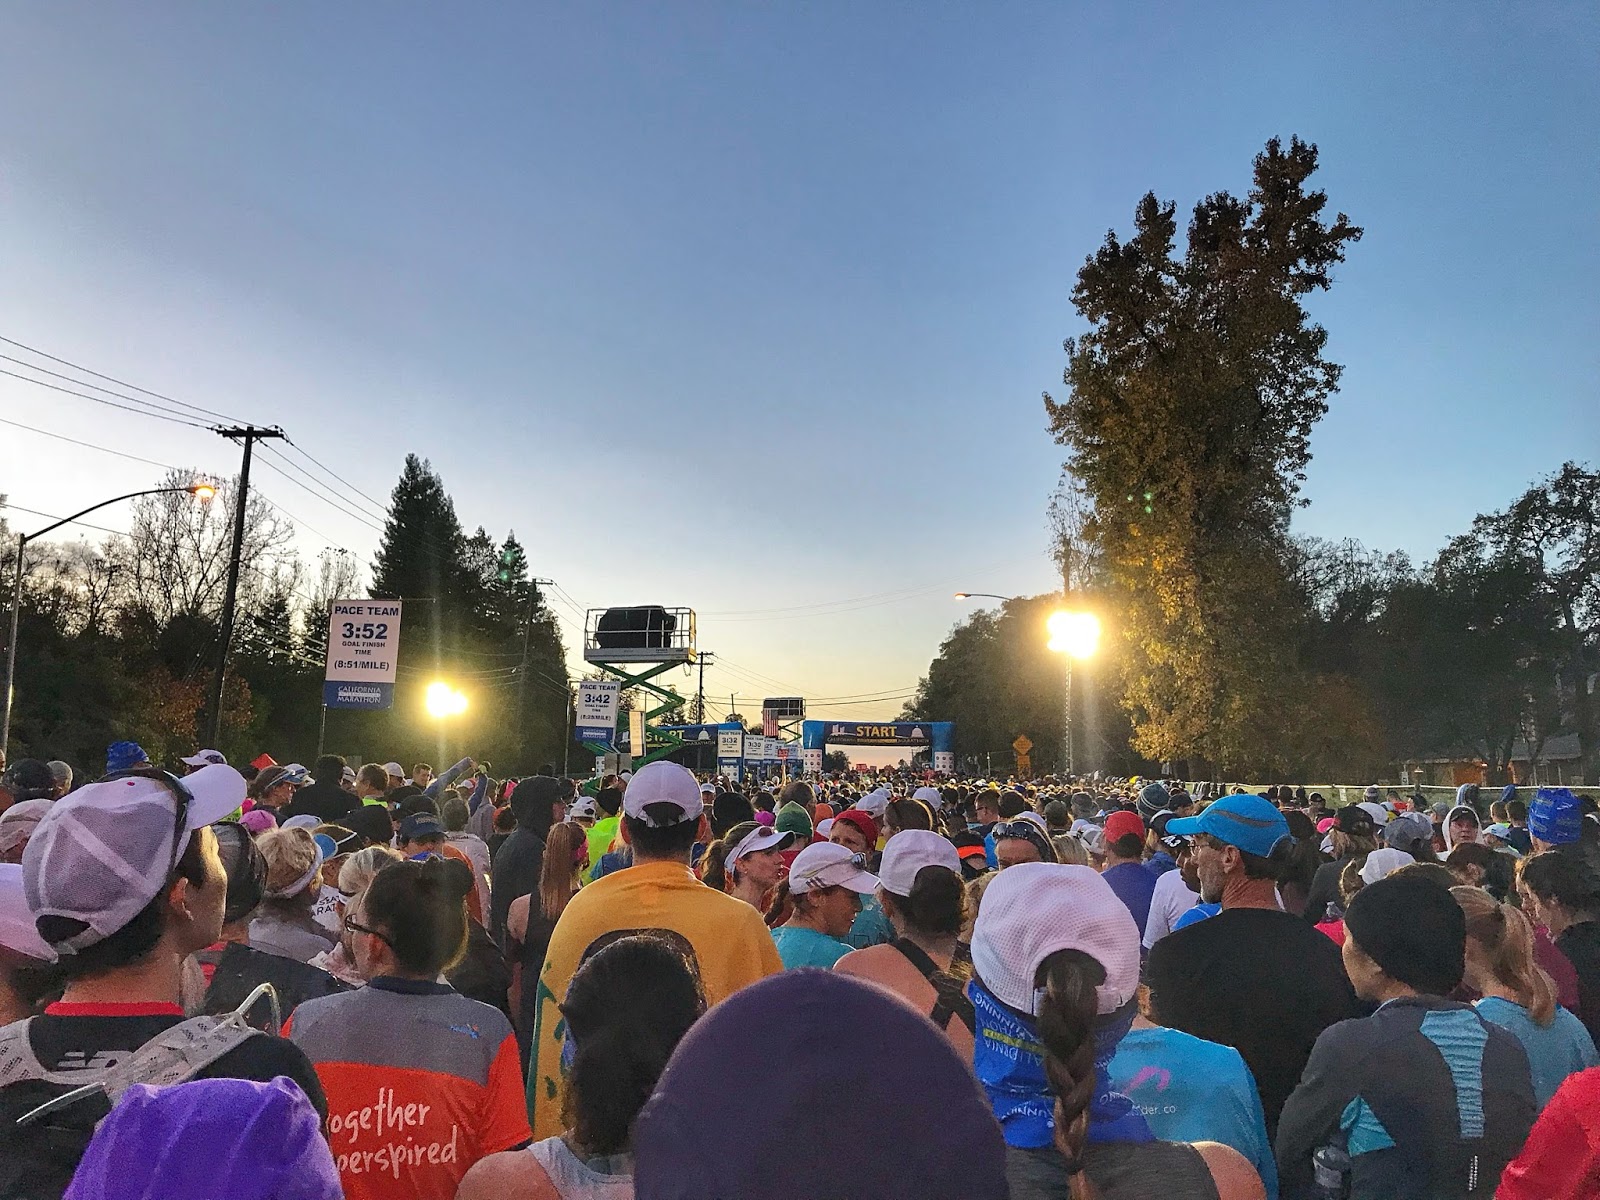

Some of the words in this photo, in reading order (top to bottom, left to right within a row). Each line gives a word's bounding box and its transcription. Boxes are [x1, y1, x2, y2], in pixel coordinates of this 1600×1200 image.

[335, 606, 363, 615] PACE
[367, 607, 399, 616] TEAM
[342, 622, 388, 640] 3:52
[334, 660, 390, 671] (8:51/MILE)
[338, 685, 381, 693] CALIFORNIA
[337, 696, 381, 704] MARATHON
[584, 693, 610, 704] 3:42
[855, 725, 898, 737] START
[329, 1087, 431, 1143] ogether
